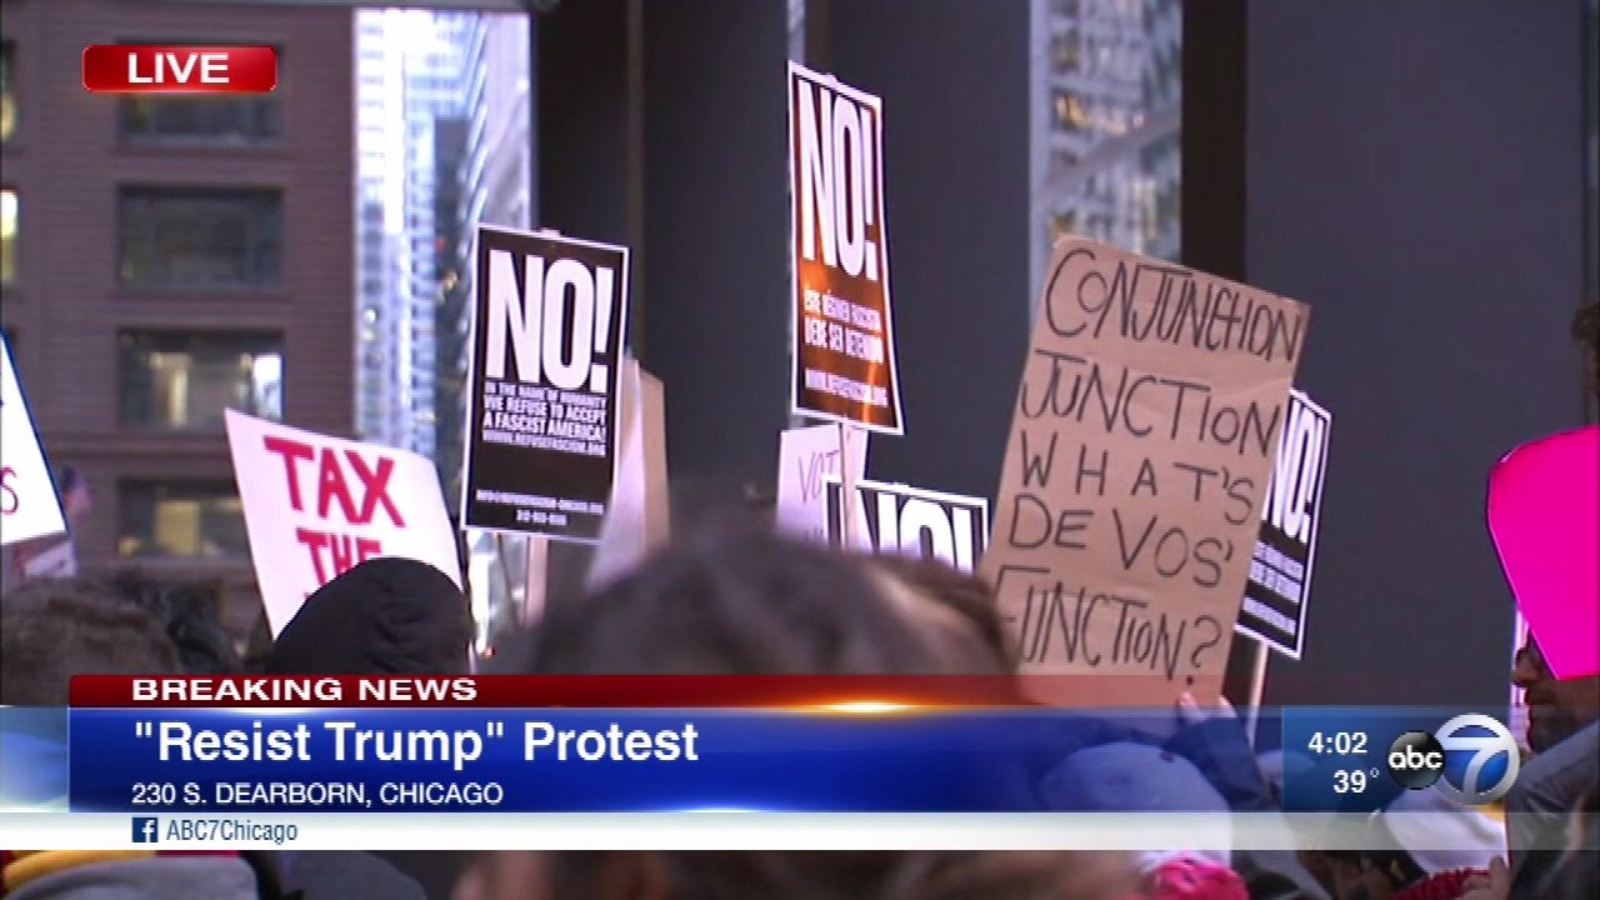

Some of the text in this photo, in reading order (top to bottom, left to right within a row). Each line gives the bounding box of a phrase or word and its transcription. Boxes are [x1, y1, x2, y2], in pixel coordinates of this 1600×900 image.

[799, 79, 878, 281] NO!
[485, 250, 613, 393] NO!
[1021, 349, 1281, 457] JUNCTION
[264, 436, 405, 528] TAX
[1009, 494, 1094, 548] DE
